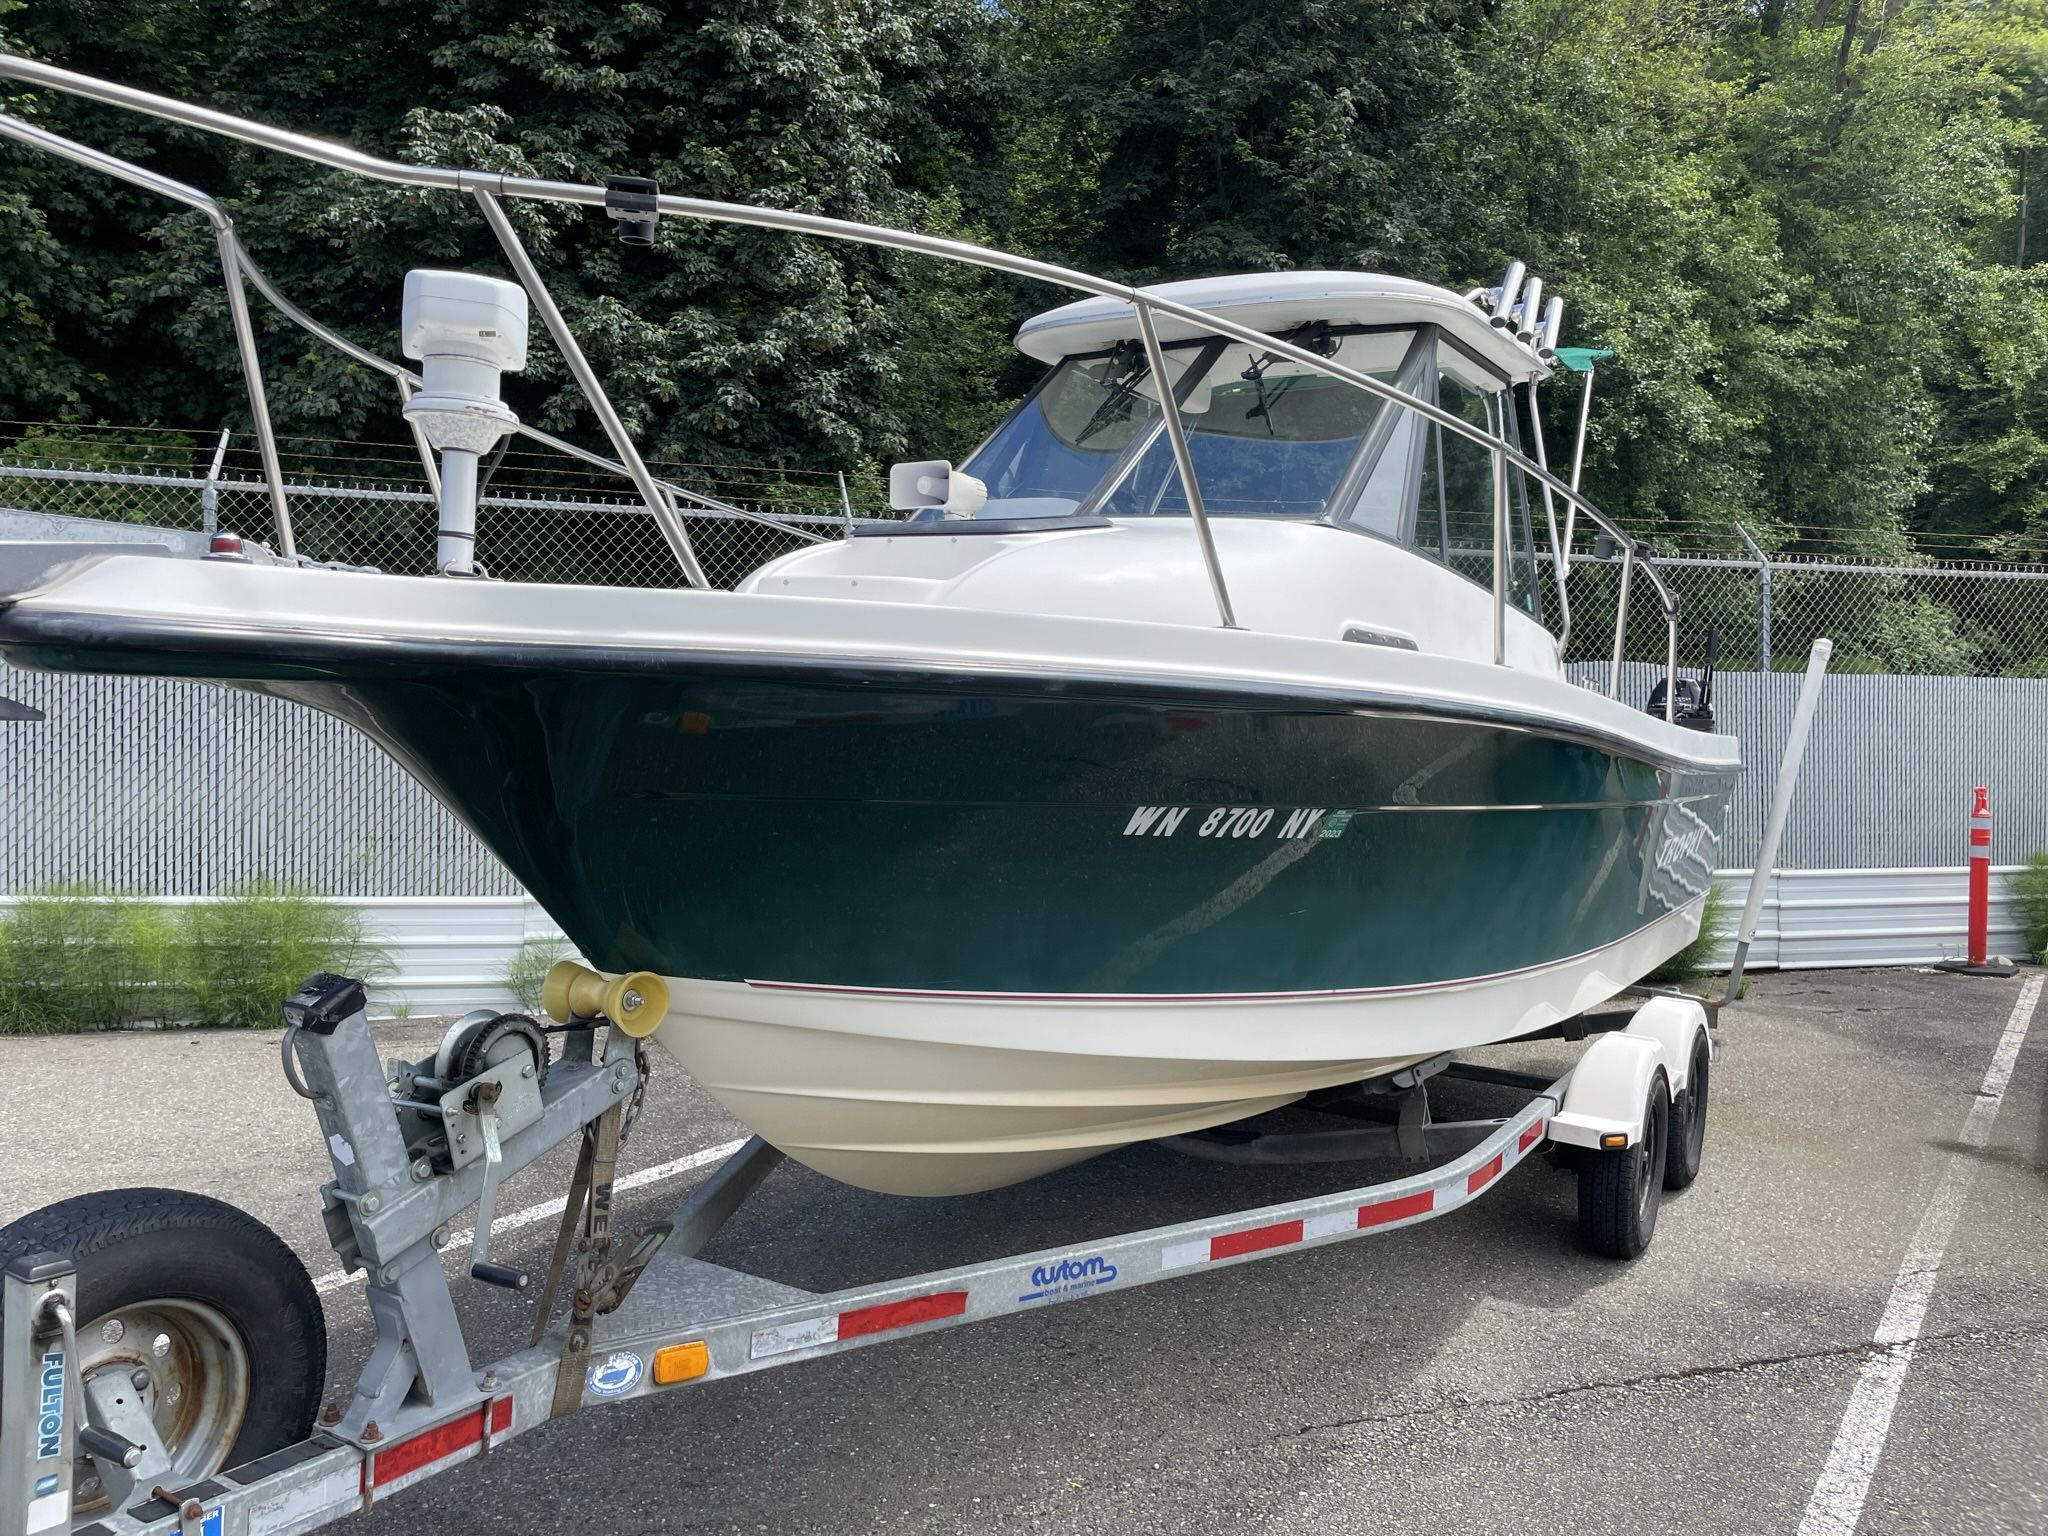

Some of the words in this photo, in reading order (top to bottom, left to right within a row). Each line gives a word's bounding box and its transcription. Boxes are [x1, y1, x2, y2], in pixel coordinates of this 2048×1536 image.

[1123, 806, 1190, 837] WN
[1198, 807, 1275, 839] 8700
[1277, 808, 1327, 839] NY
[1319, 829, 1342, 838] 2023
[37, 1352, 64, 1460] FULTON
